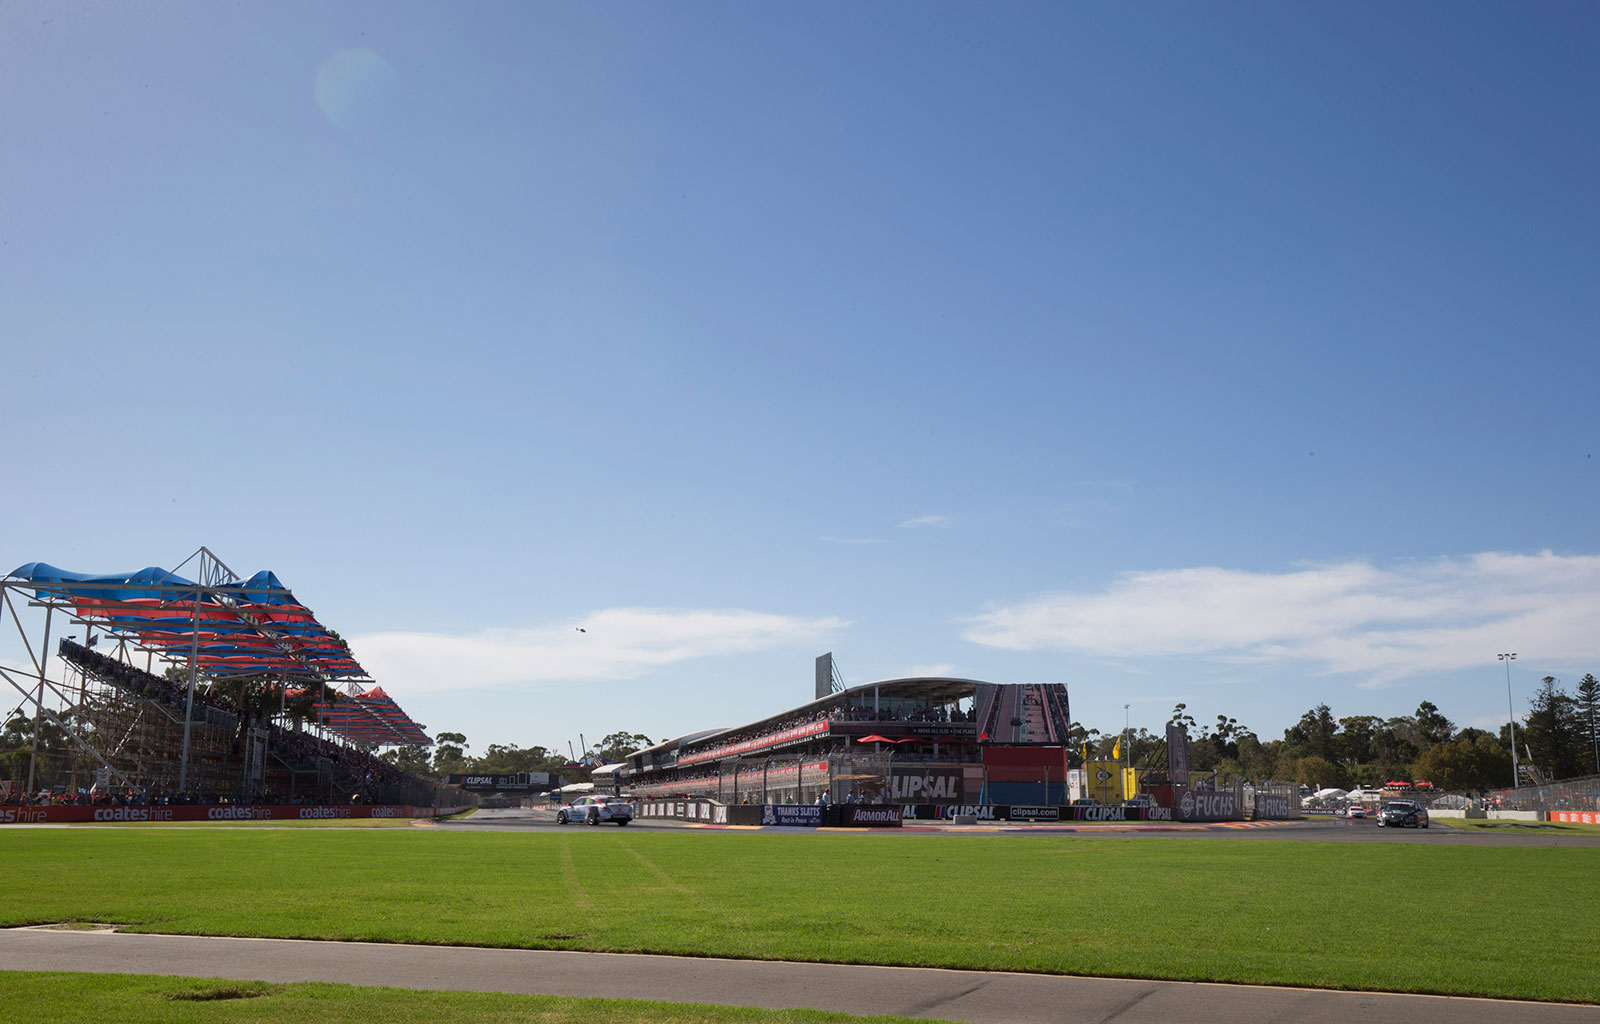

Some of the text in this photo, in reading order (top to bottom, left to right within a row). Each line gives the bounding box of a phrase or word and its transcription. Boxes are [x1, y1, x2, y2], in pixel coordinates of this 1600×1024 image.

[467, 776, 493, 785] CLIPSAL
[208, 805, 272, 819] coates hire
[300, 806, 335, 819] coates
[371, 806, 394, 818] coates
[777, 806, 821, 816] THANKS SLATTS
[946, 805, 995, 819] CLIPSAL
[1012, 807, 1057, 817] clipsal.com
[1195, 796, 1233, 816] FUCHS
[1266, 799, 1287, 816] FUCHS
[17, 807, 47, 823] hire
[94, 806, 173, 821] coates hire
[1085, 807, 1126, 820] CLIPSAL
[1148, 807, 1172, 820] CLIPSAL
